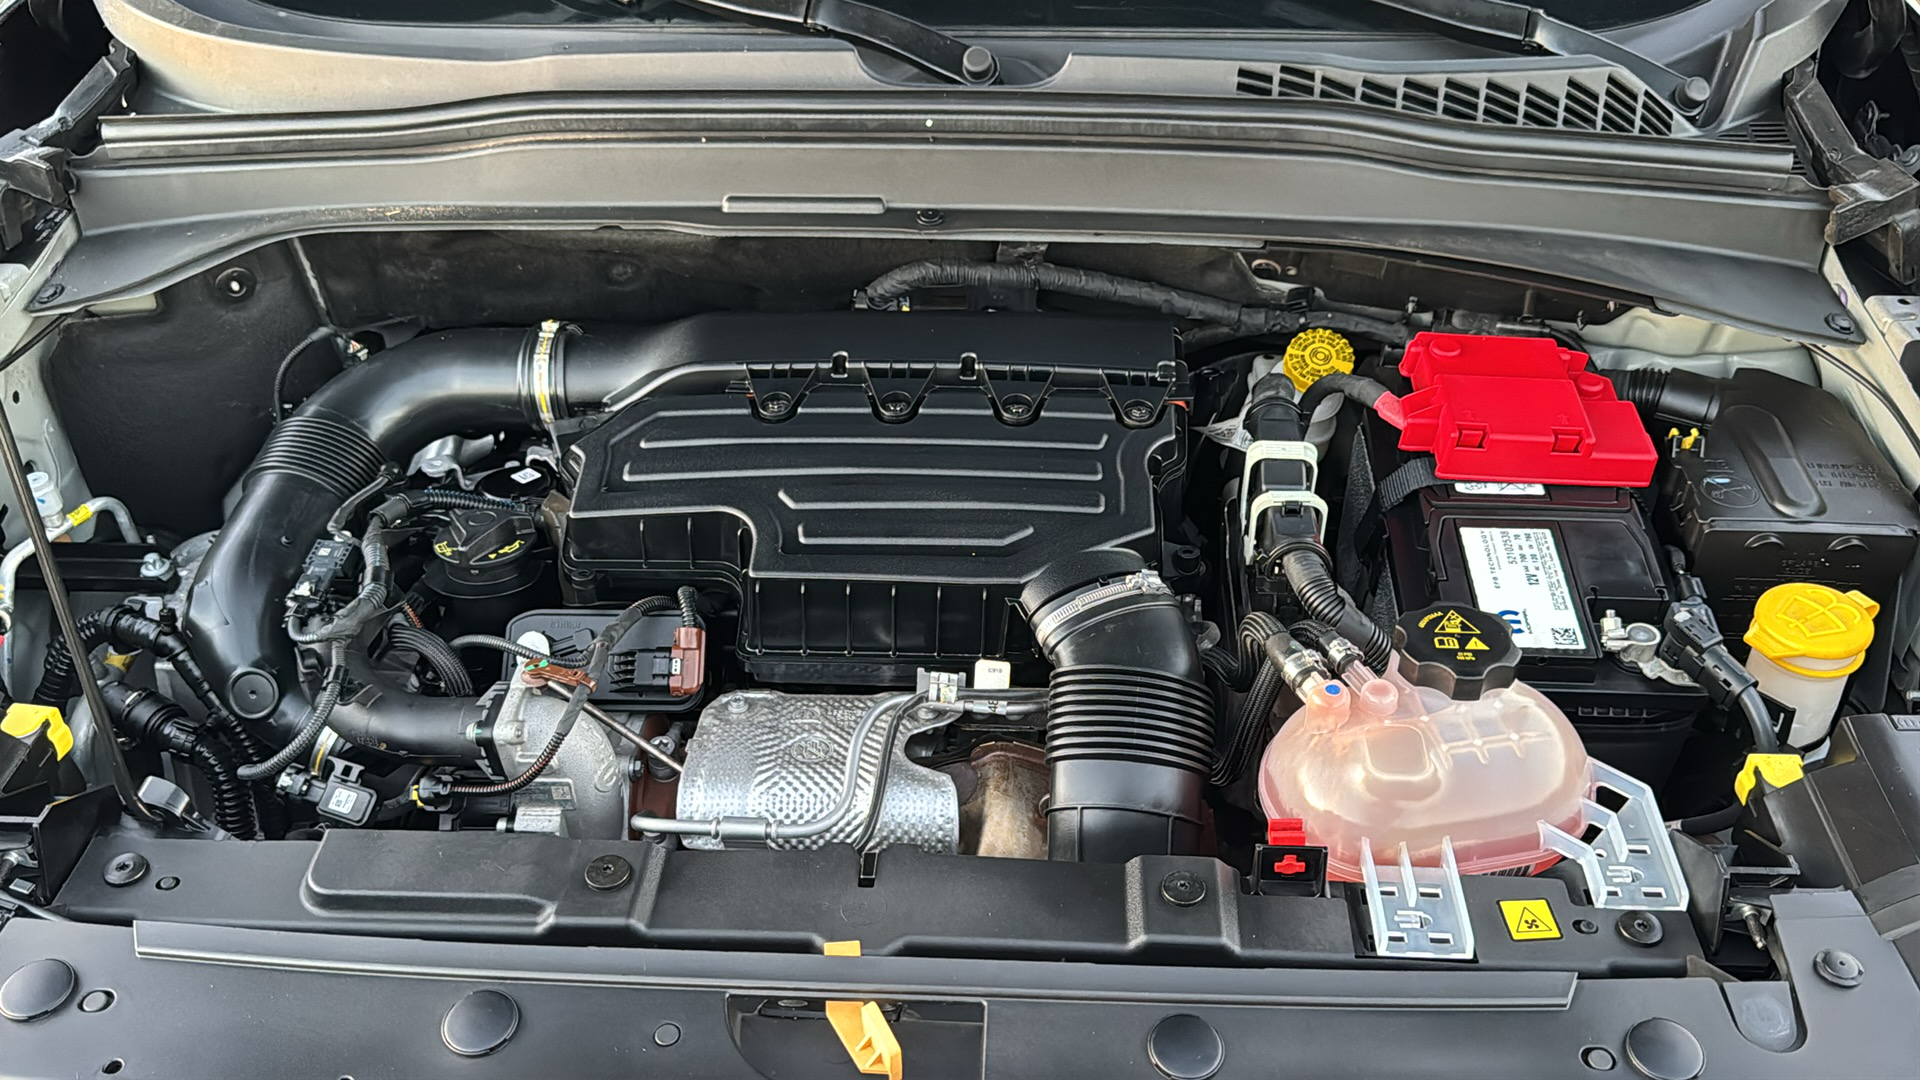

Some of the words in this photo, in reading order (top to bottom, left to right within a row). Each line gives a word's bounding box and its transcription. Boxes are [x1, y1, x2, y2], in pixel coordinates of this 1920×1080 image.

[1480, 530, 1497, 574] TECHNOLOGY
[1500, 530, 1518, 565] 52102538
[1525, 573, 1540, 585] 12V
